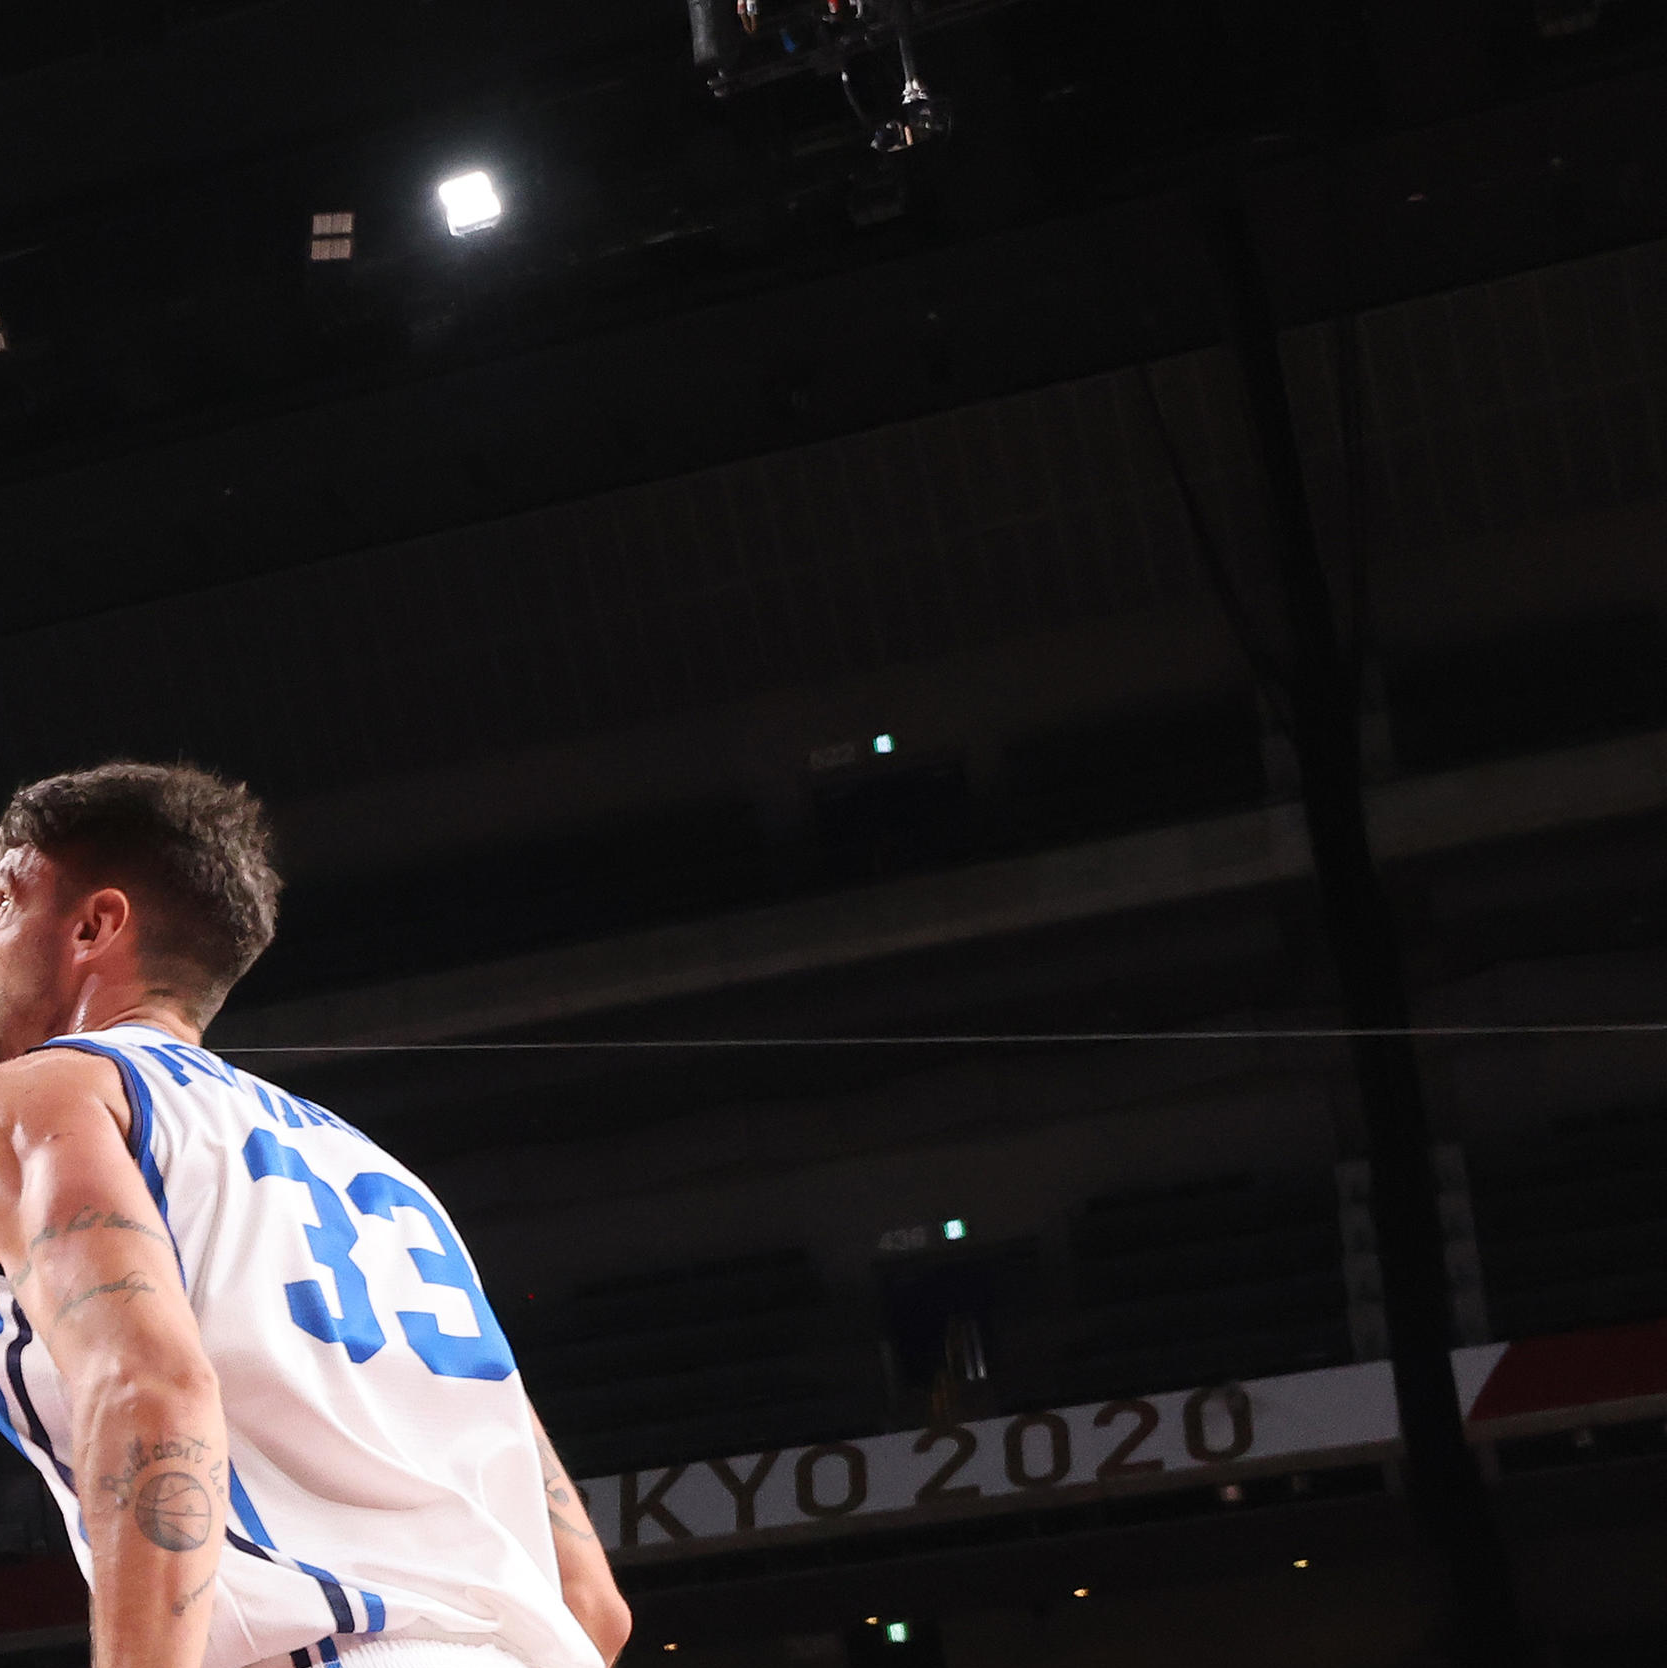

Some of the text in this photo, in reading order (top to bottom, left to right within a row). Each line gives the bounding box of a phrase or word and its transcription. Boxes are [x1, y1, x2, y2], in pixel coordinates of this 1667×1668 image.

[243, 1127, 521, 1381] 33
[579, 1382, 1254, 1548] KYO 2020
